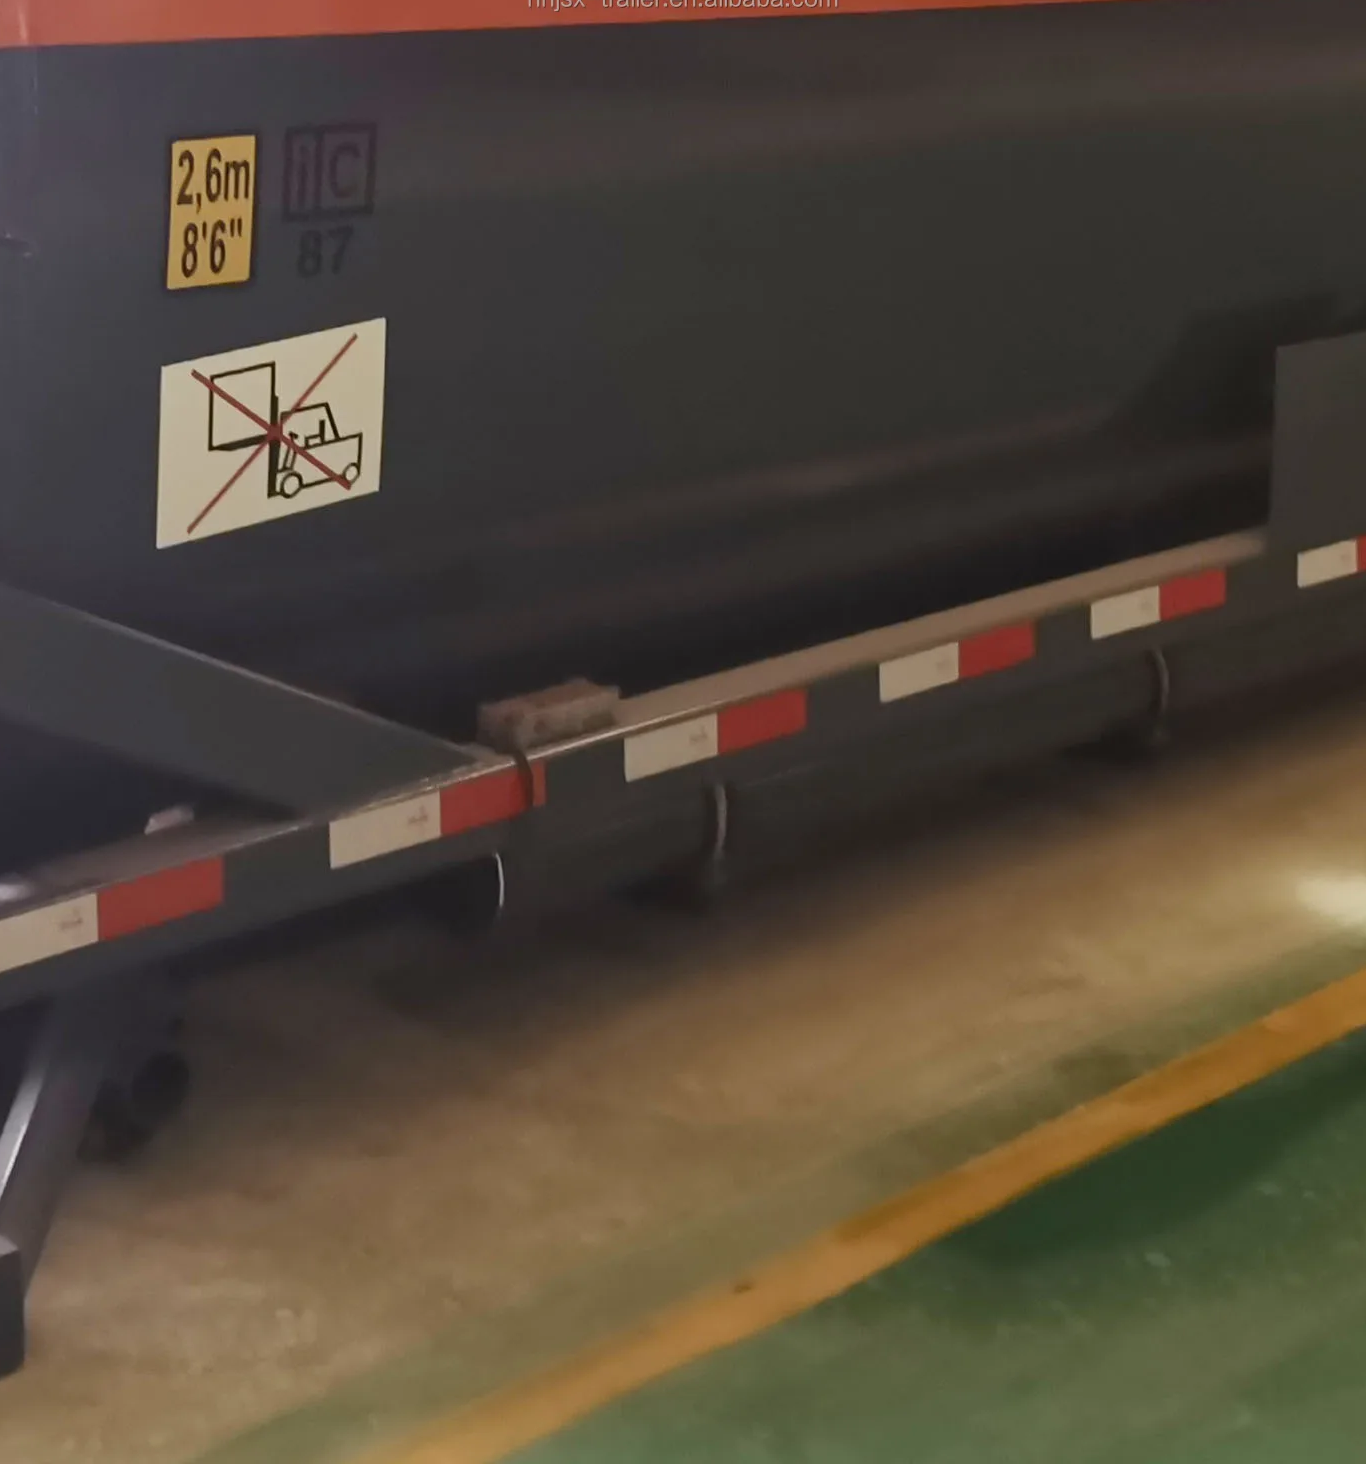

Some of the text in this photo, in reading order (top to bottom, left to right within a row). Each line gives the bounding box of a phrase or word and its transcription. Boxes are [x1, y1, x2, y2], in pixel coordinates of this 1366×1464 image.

[176, 147, 251, 214] 2,6m
[180, 217, 243, 279] 8'6"
[296, 224, 354, 278] 87
